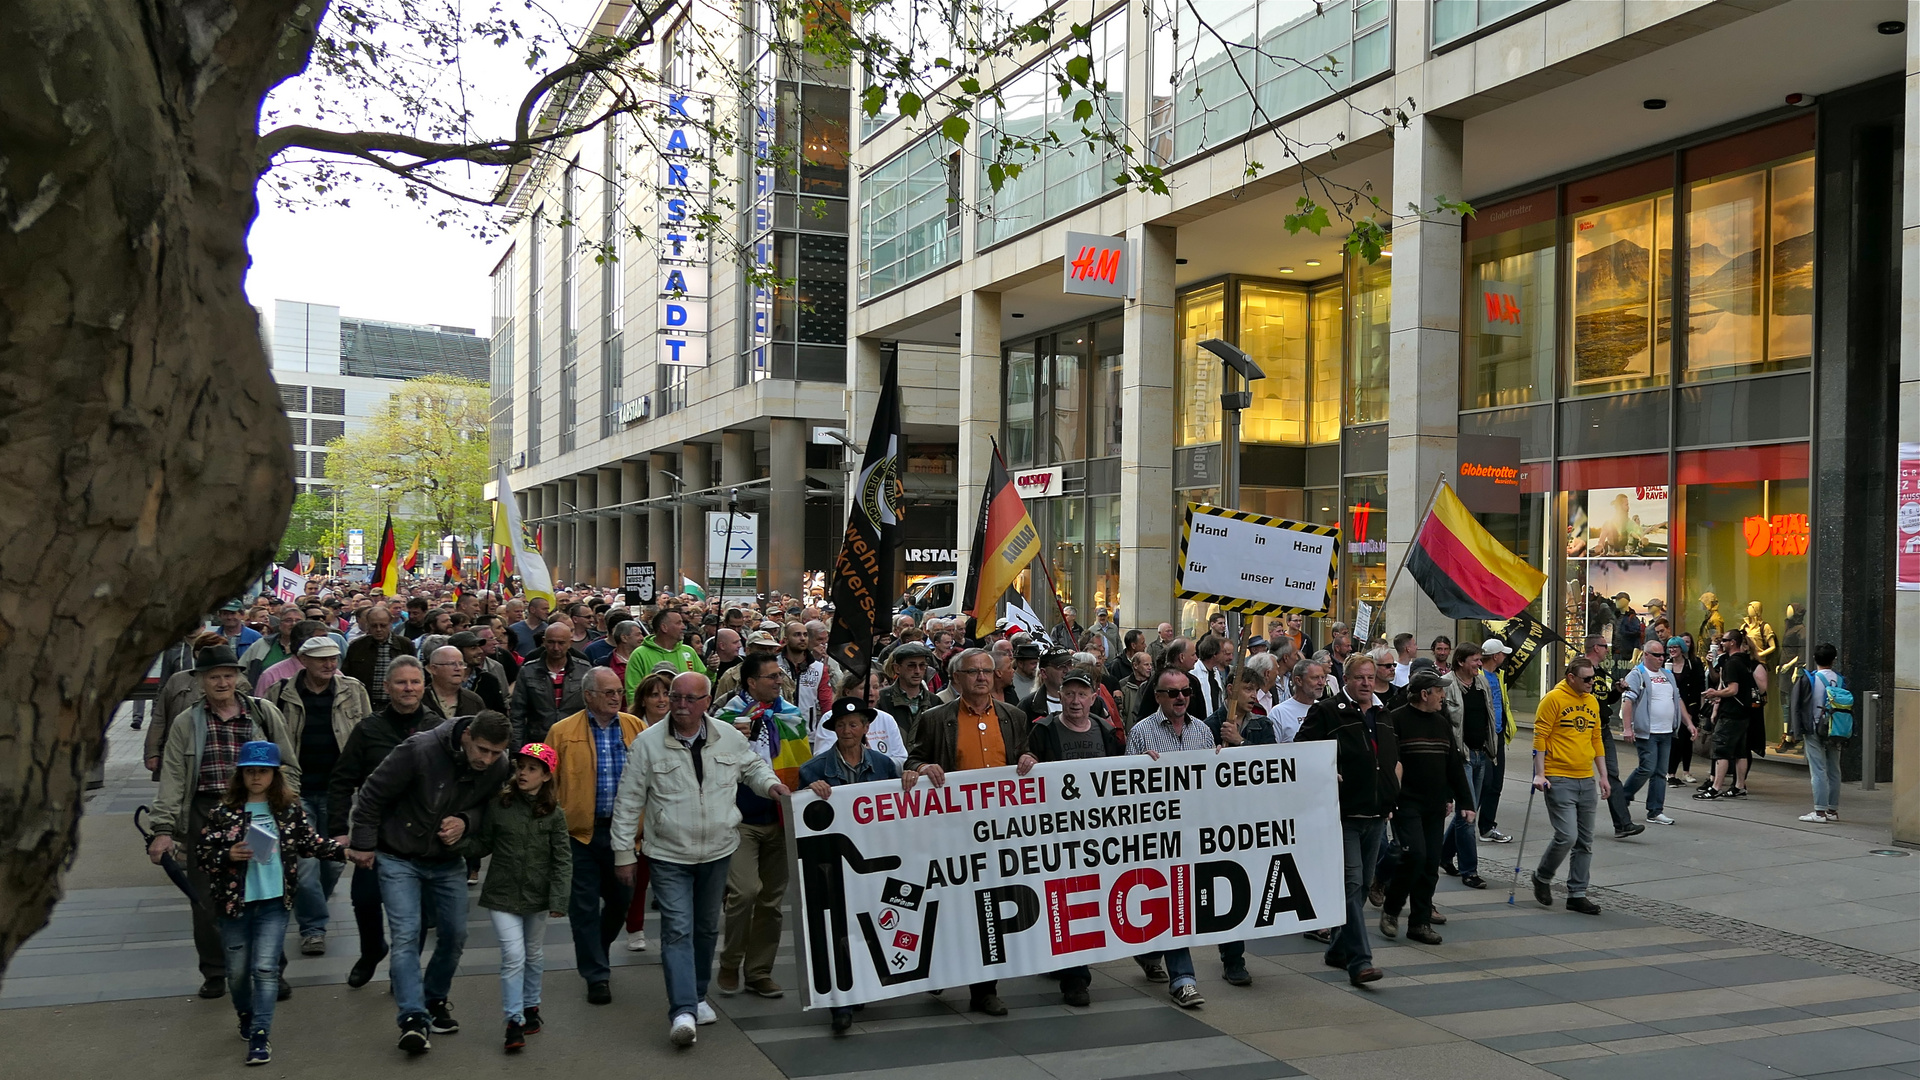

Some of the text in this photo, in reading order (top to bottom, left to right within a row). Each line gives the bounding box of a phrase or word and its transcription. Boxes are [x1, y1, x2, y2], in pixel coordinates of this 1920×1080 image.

[665, 93, 689, 362] KARSTADT
[1490, 204, 1532, 222] Globetrotter
[1071, 246, 1120, 284] H&M
[1018, 473, 1052, 493] orsay
[1460, 462, 1518, 478] Globetrotter
[1195, 523, 1322, 554] Hand in Hand
[626, 566, 654, 575] MERKEL
[1189, 561, 1316, 591] für unser Land!
[852, 757, 1297, 825] GEWALTFREI & VEREINT GEGEN
[974, 800, 1181, 844] GLAUBENSKRIEGE
[926, 818, 1297, 890] AUF DEUTSCHEM BODEN!
[975, 852, 1317, 966] PEGIDA
[1116, 890, 1125, 927] GEGEN
[1262, 859, 1282, 922] ABENDLANDES
[982, 891, 1000, 963] PATRIOTISCHE
[1050, 890, 1064, 944] EUROPÄER
